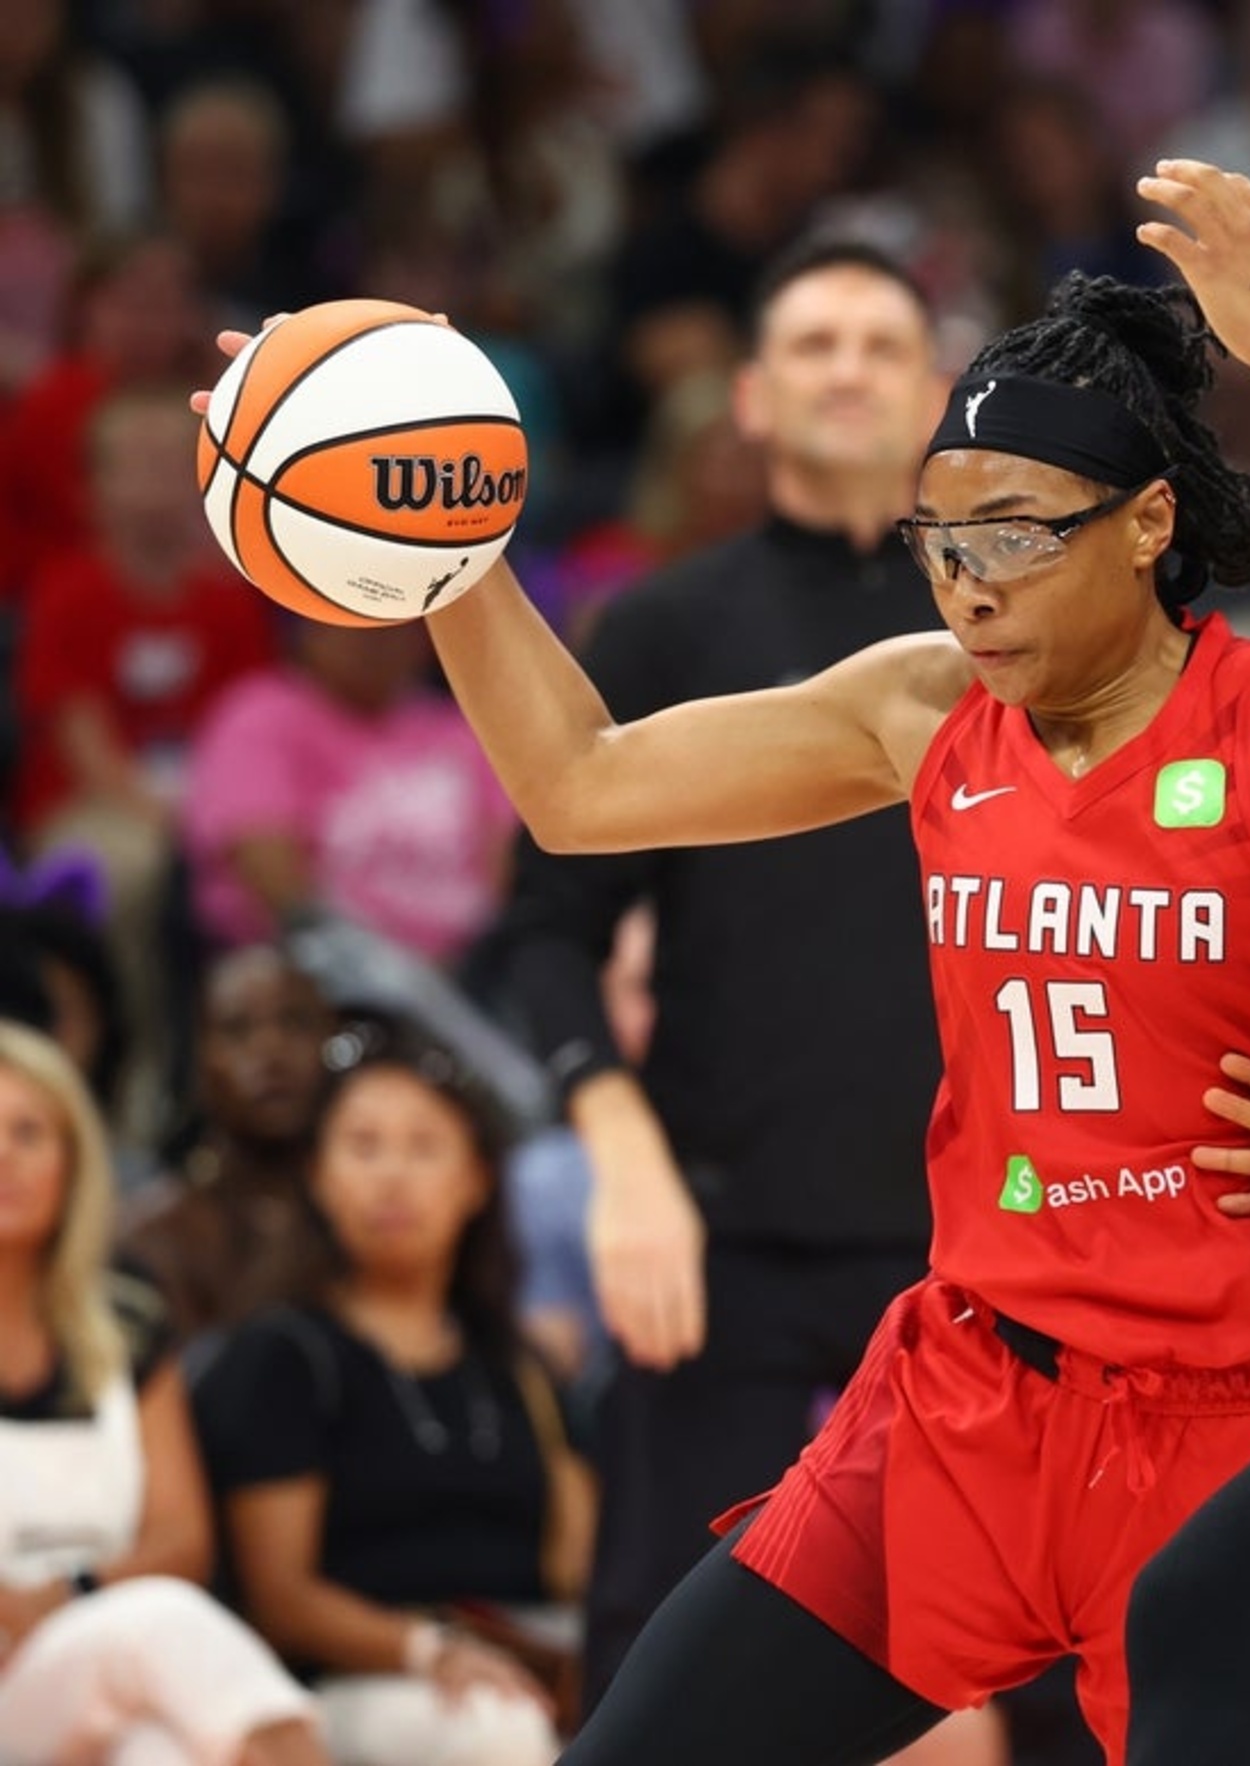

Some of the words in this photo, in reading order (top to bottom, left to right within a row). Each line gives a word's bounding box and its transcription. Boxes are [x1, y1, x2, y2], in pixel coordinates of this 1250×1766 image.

[926, 873, 1226, 962] ATLANTA
[995, 977, 1121, 1113] 15
[1117, 1164, 1187, 1202] App
